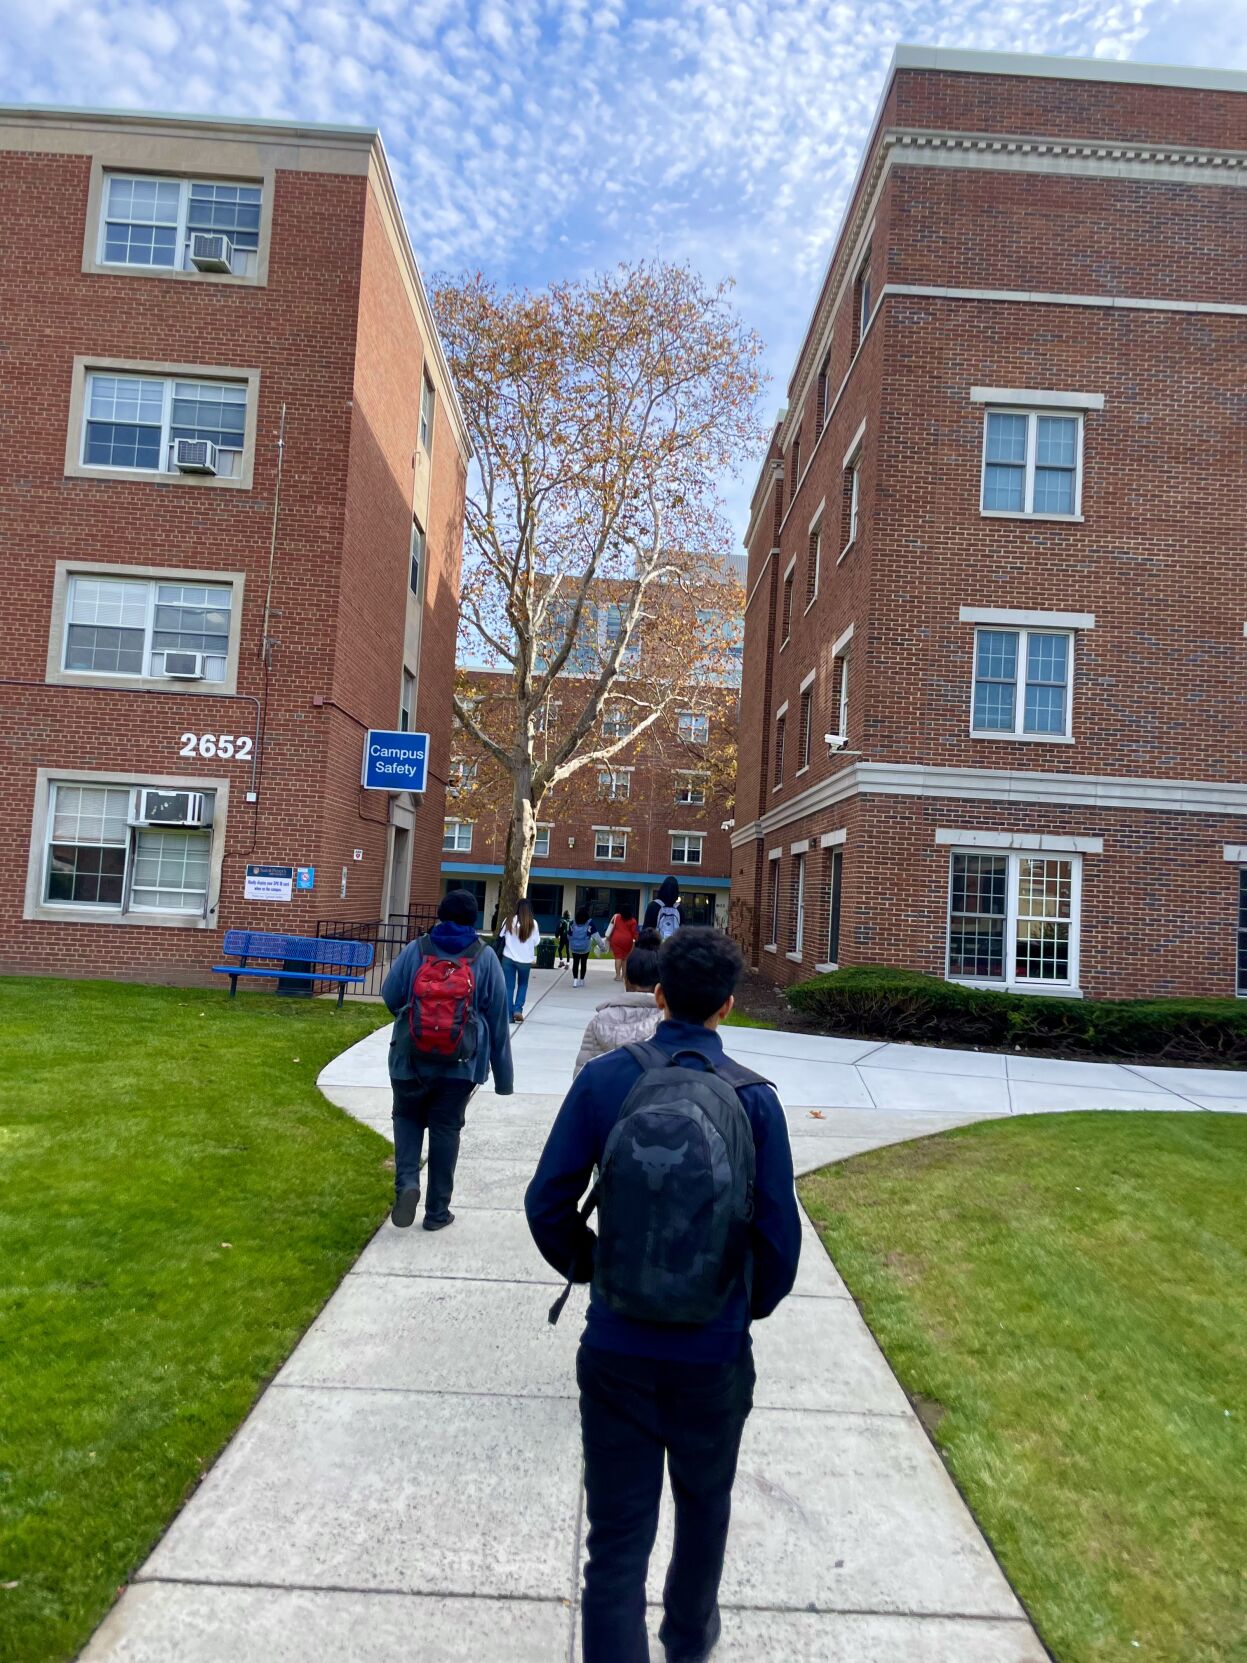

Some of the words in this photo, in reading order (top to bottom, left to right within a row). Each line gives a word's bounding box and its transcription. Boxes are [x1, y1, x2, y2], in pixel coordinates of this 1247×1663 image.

[180, 733, 253, 760] 2652
[370, 744, 424, 761] Campus
[375, 761, 417, 778] Safety
